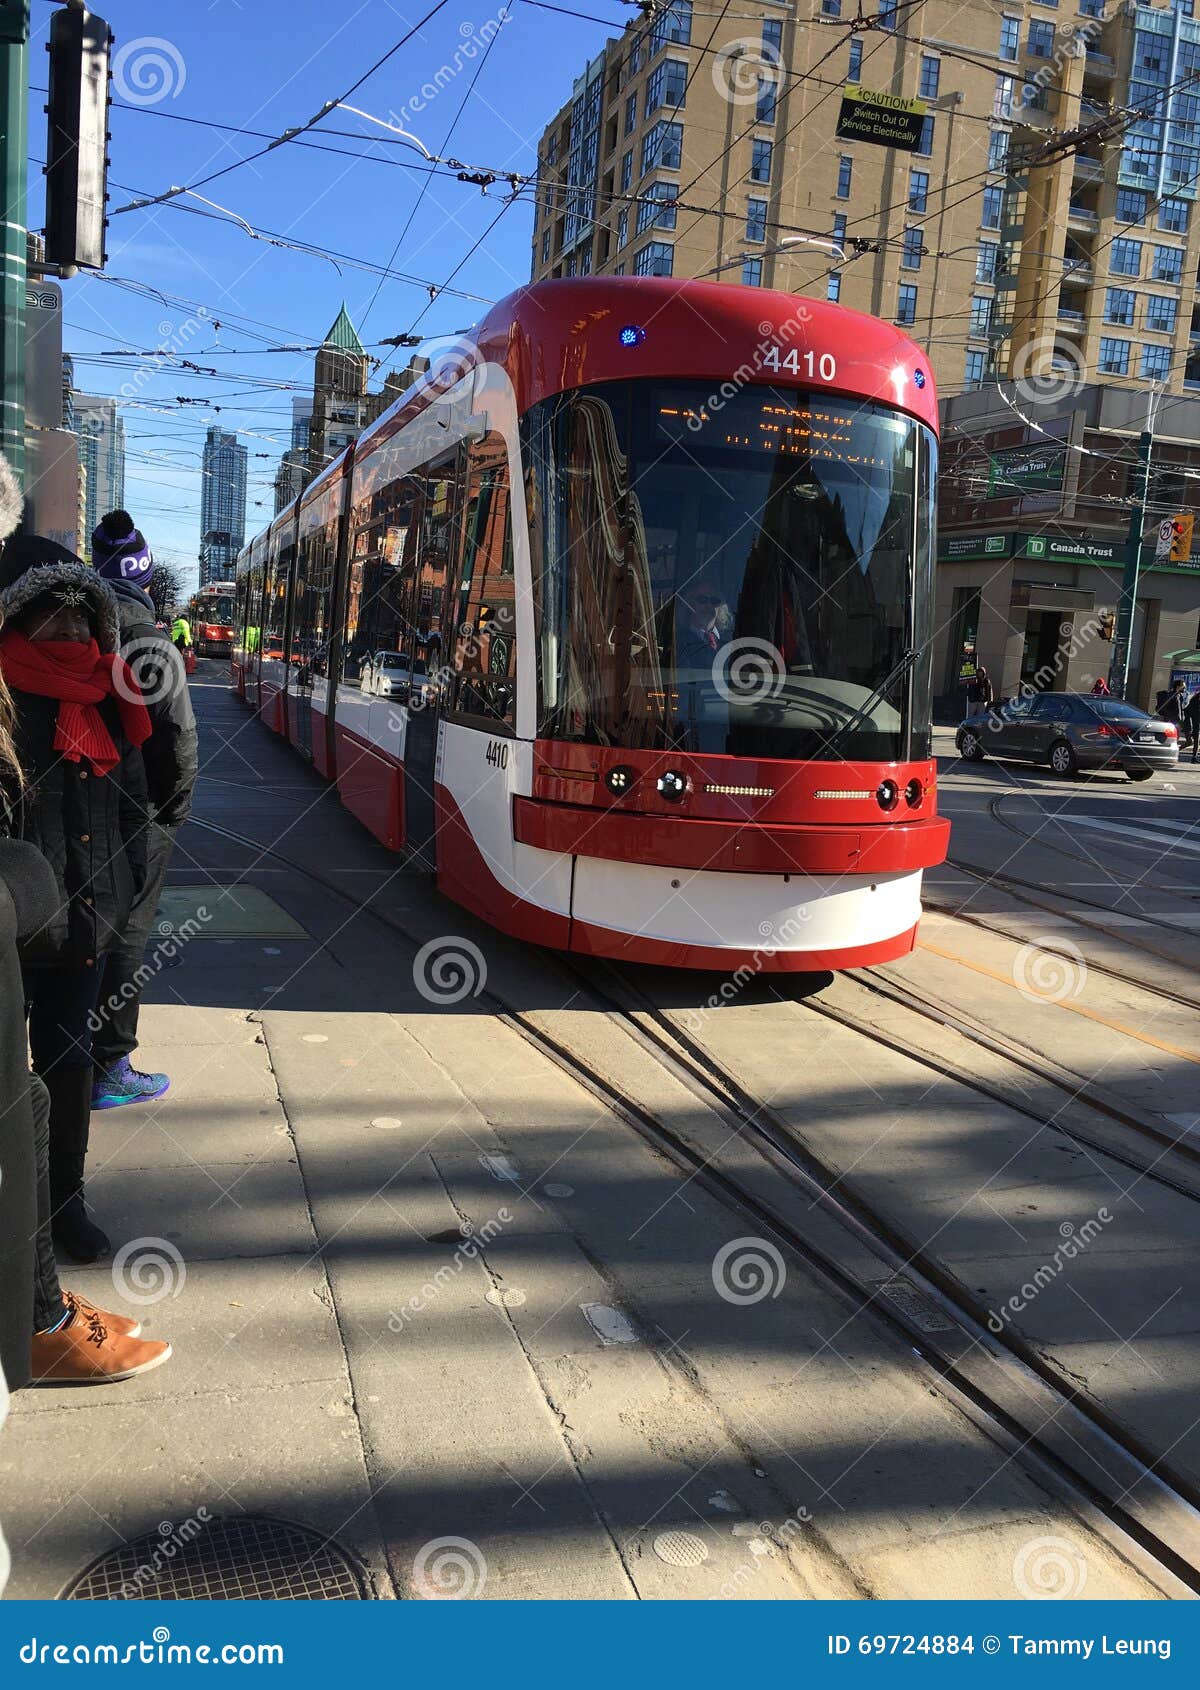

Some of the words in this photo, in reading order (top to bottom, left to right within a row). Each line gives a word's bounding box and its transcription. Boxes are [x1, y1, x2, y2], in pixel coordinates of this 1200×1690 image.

[862, 90, 908, 111] CAUTION
[853, 107, 881, 121] Switch
[882, 113, 897, 127] Out
[898, 117, 910, 128] Of
[841, 117, 872, 133] Service
[872, 124, 917, 144] Electrically
[762, 346, 836, 381] 4410
[1050, 542, 1086, 554] Canada
[1087, 546, 1113, 557] Trust
[485, 740, 509, 770] 4410
